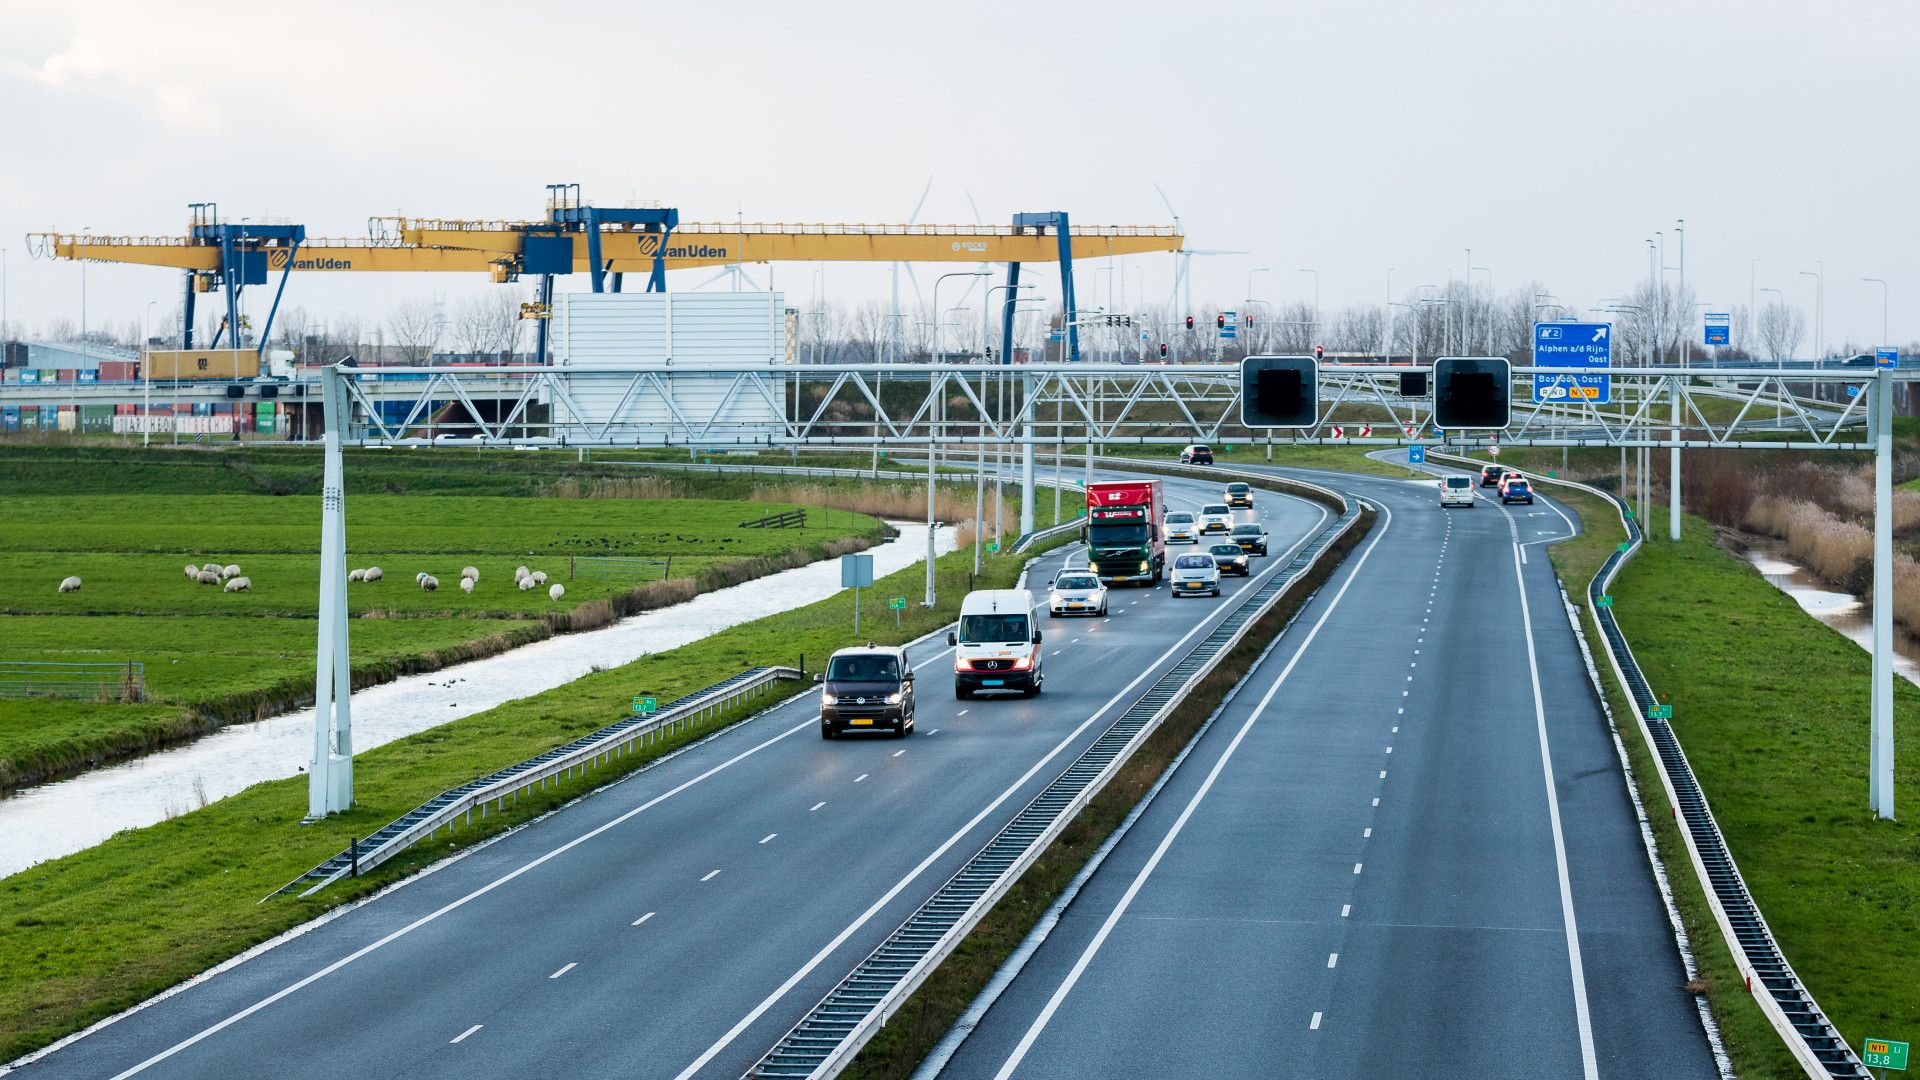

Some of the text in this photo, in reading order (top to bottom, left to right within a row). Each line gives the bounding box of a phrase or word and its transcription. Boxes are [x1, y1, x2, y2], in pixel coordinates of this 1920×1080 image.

[1538, 345, 1568, 353] Alphen
[1588, 355, 1607, 363] Oost
[1871, 1044, 1901, 1054] N11 Li
[1867, 1053, 1890, 1066] 13,8
